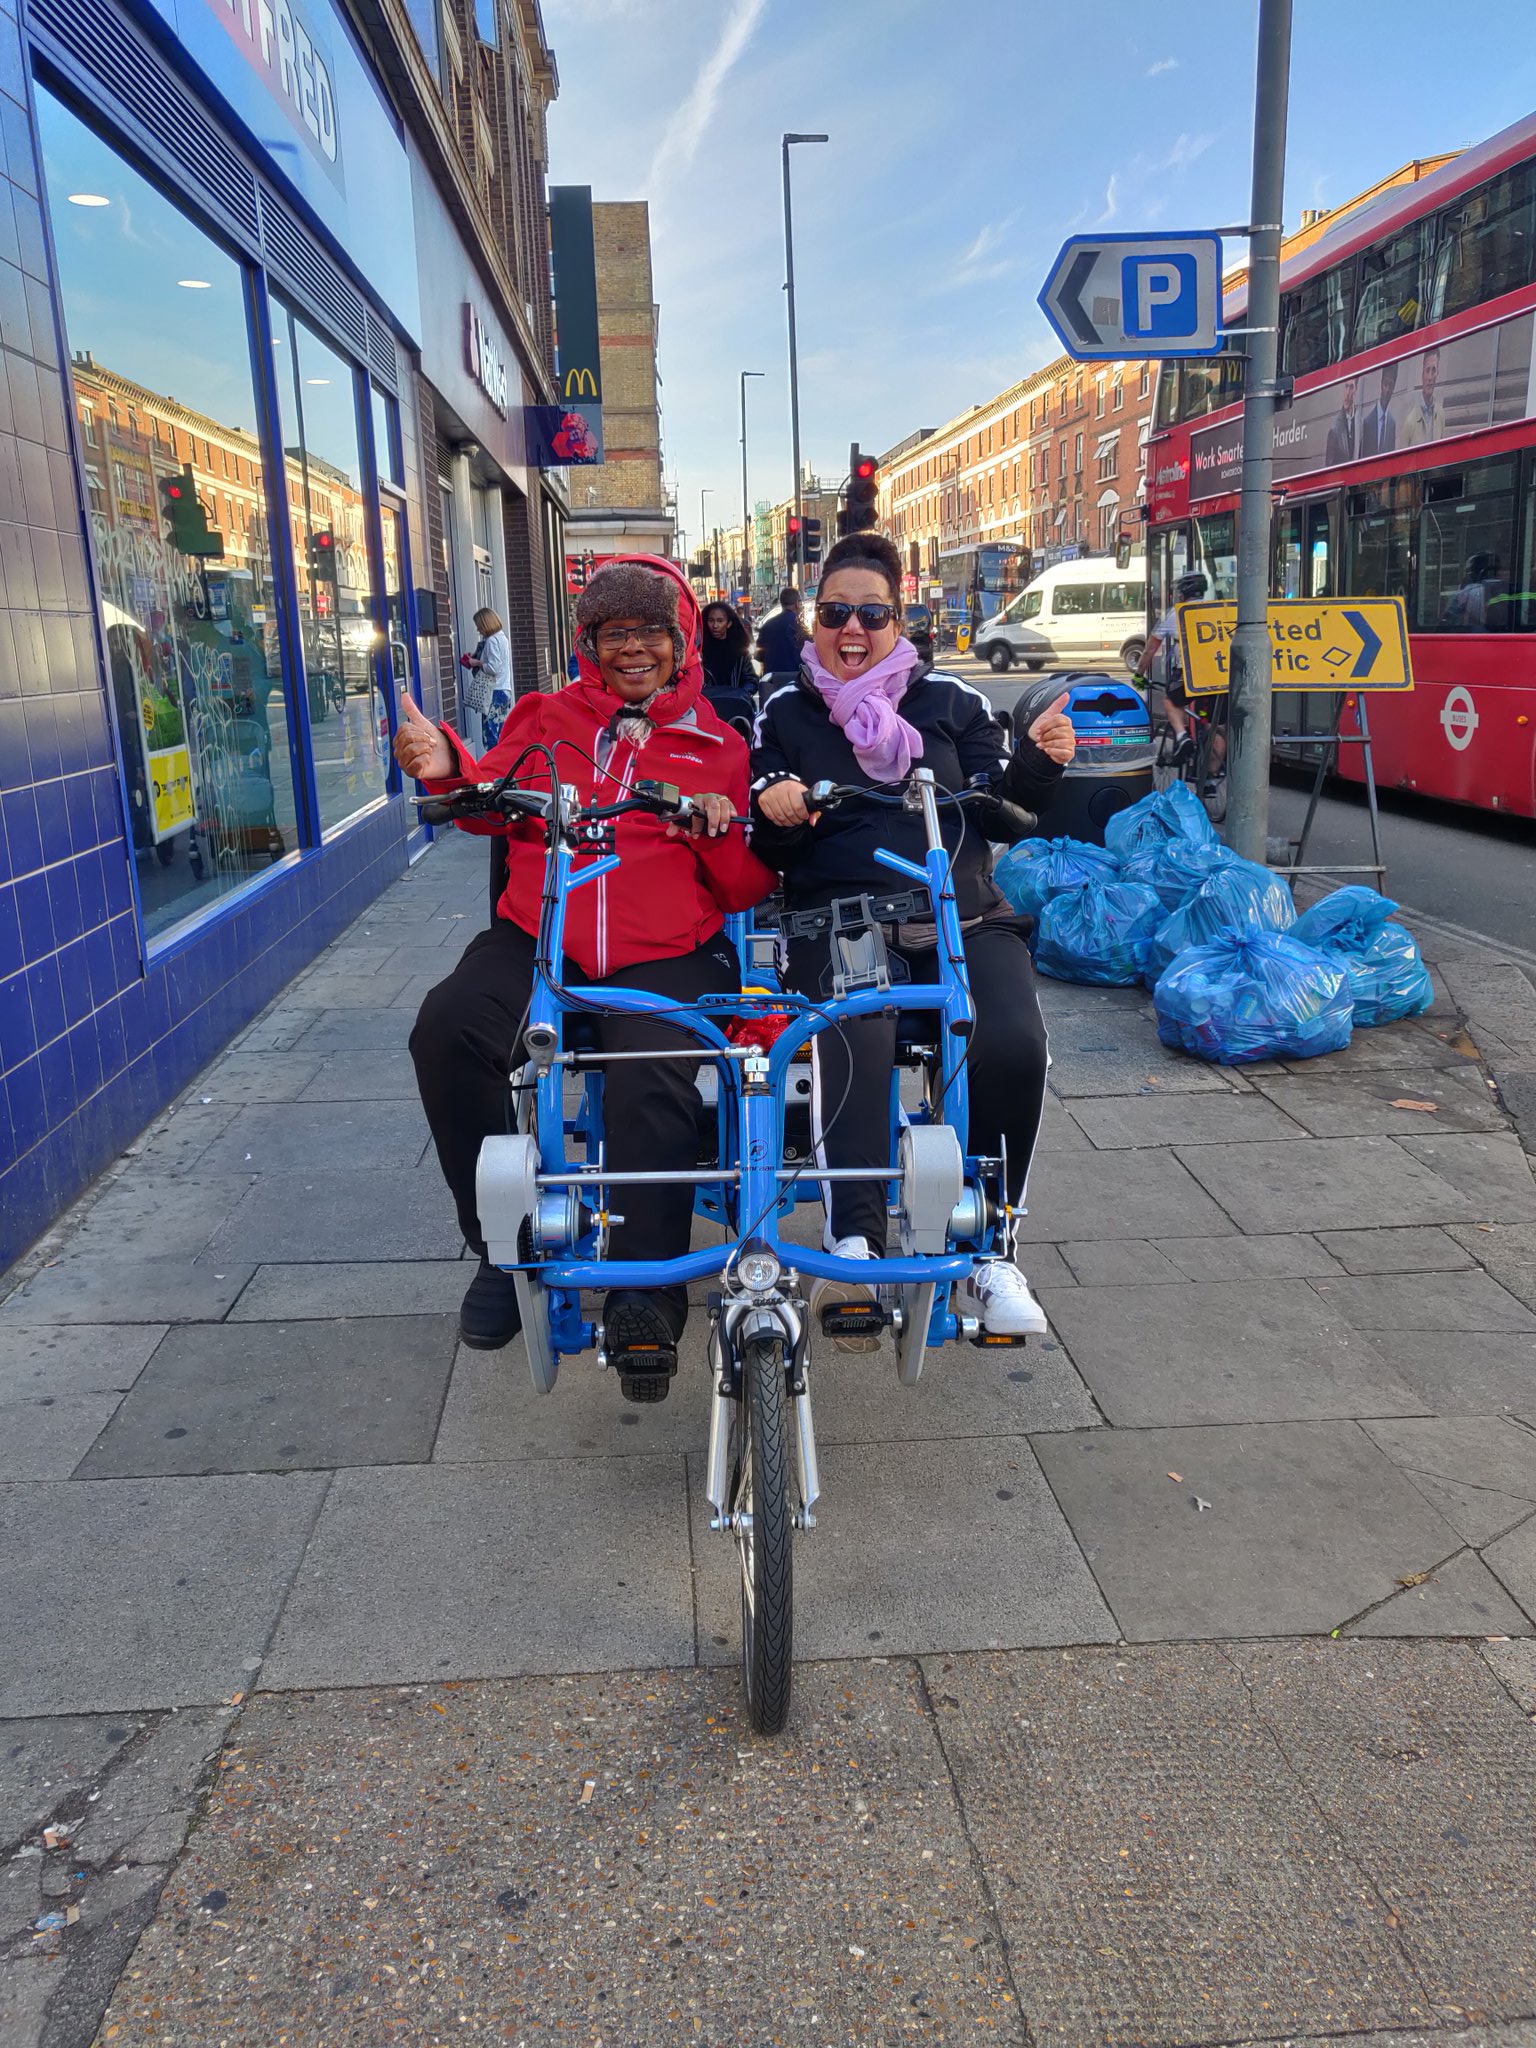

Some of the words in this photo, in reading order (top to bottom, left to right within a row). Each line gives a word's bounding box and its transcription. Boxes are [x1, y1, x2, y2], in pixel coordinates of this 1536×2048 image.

[1137, 263, 1181, 331] P
[1195, 445, 1216, 472] Work
[1217, 442, 1243, 466] Smarte
[1272, 418, 1308, 449] Harder.
[1196, 617, 1323, 644] Divted
[1214, 648, 1311, 673] tfic
